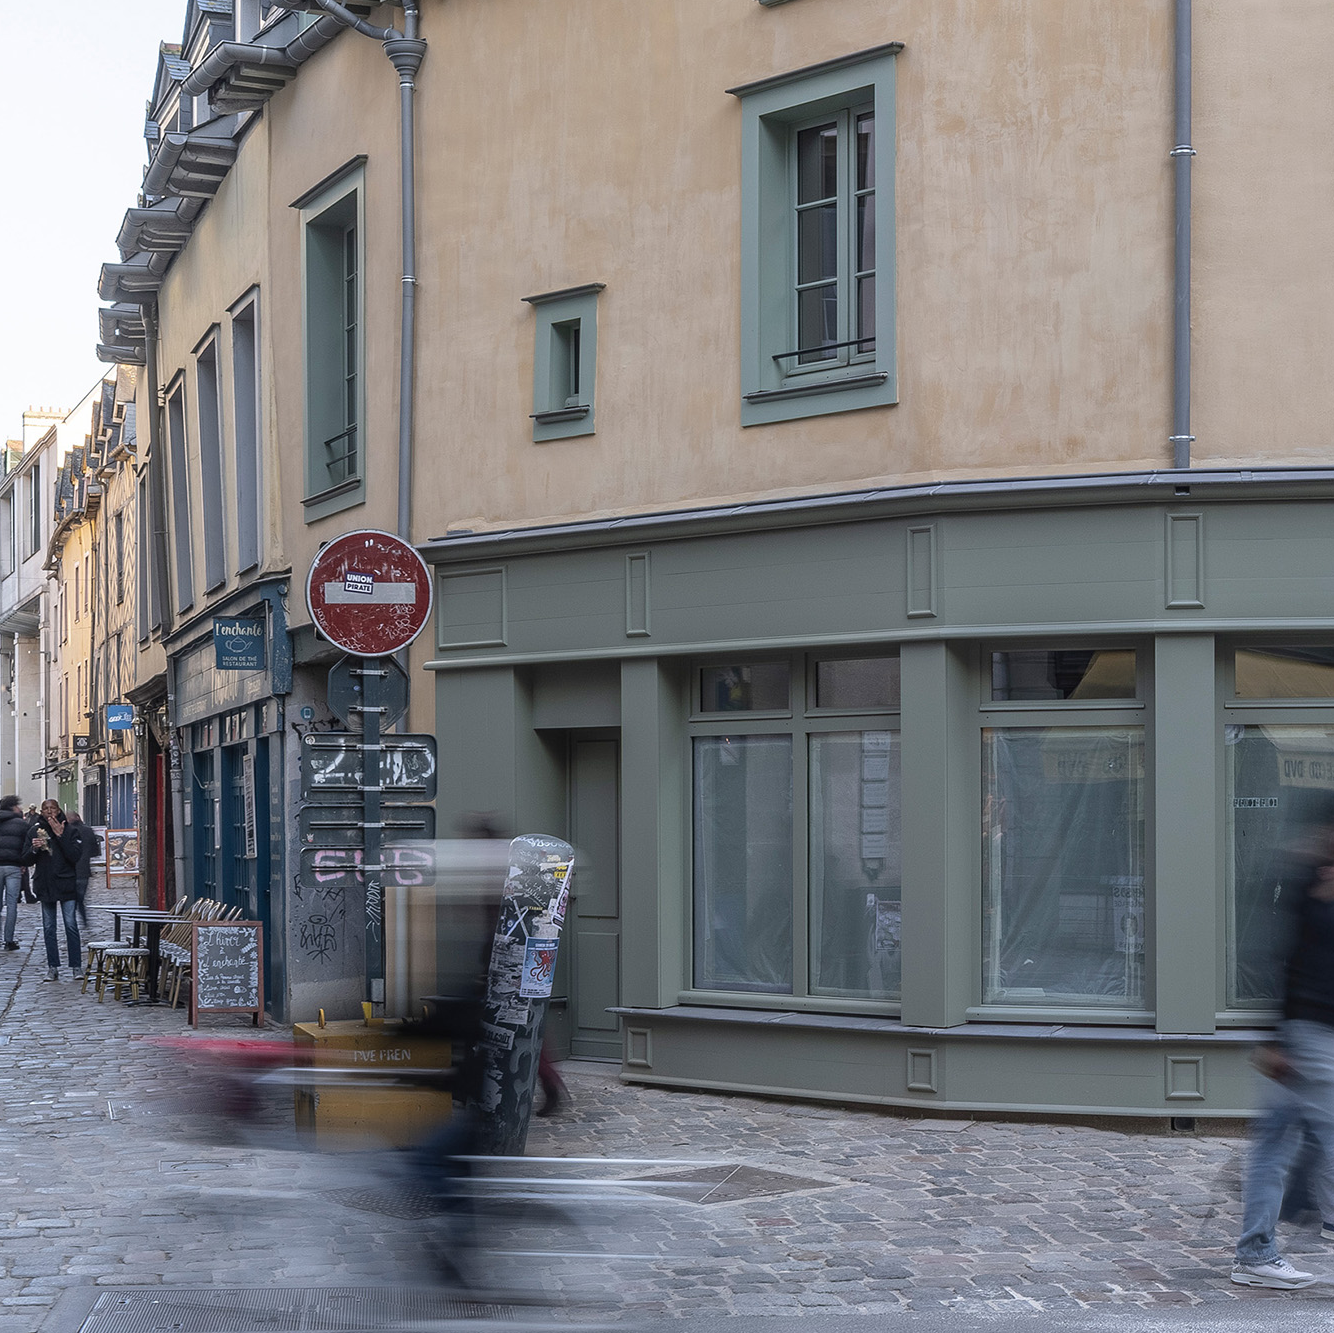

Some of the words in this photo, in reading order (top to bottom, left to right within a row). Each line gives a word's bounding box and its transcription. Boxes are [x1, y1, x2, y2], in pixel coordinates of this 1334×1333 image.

[346, 573, 373, 584] UNION
[347, 583, 371, 592] PIRATE
[215, 621, 263, 636] l'enchanté
